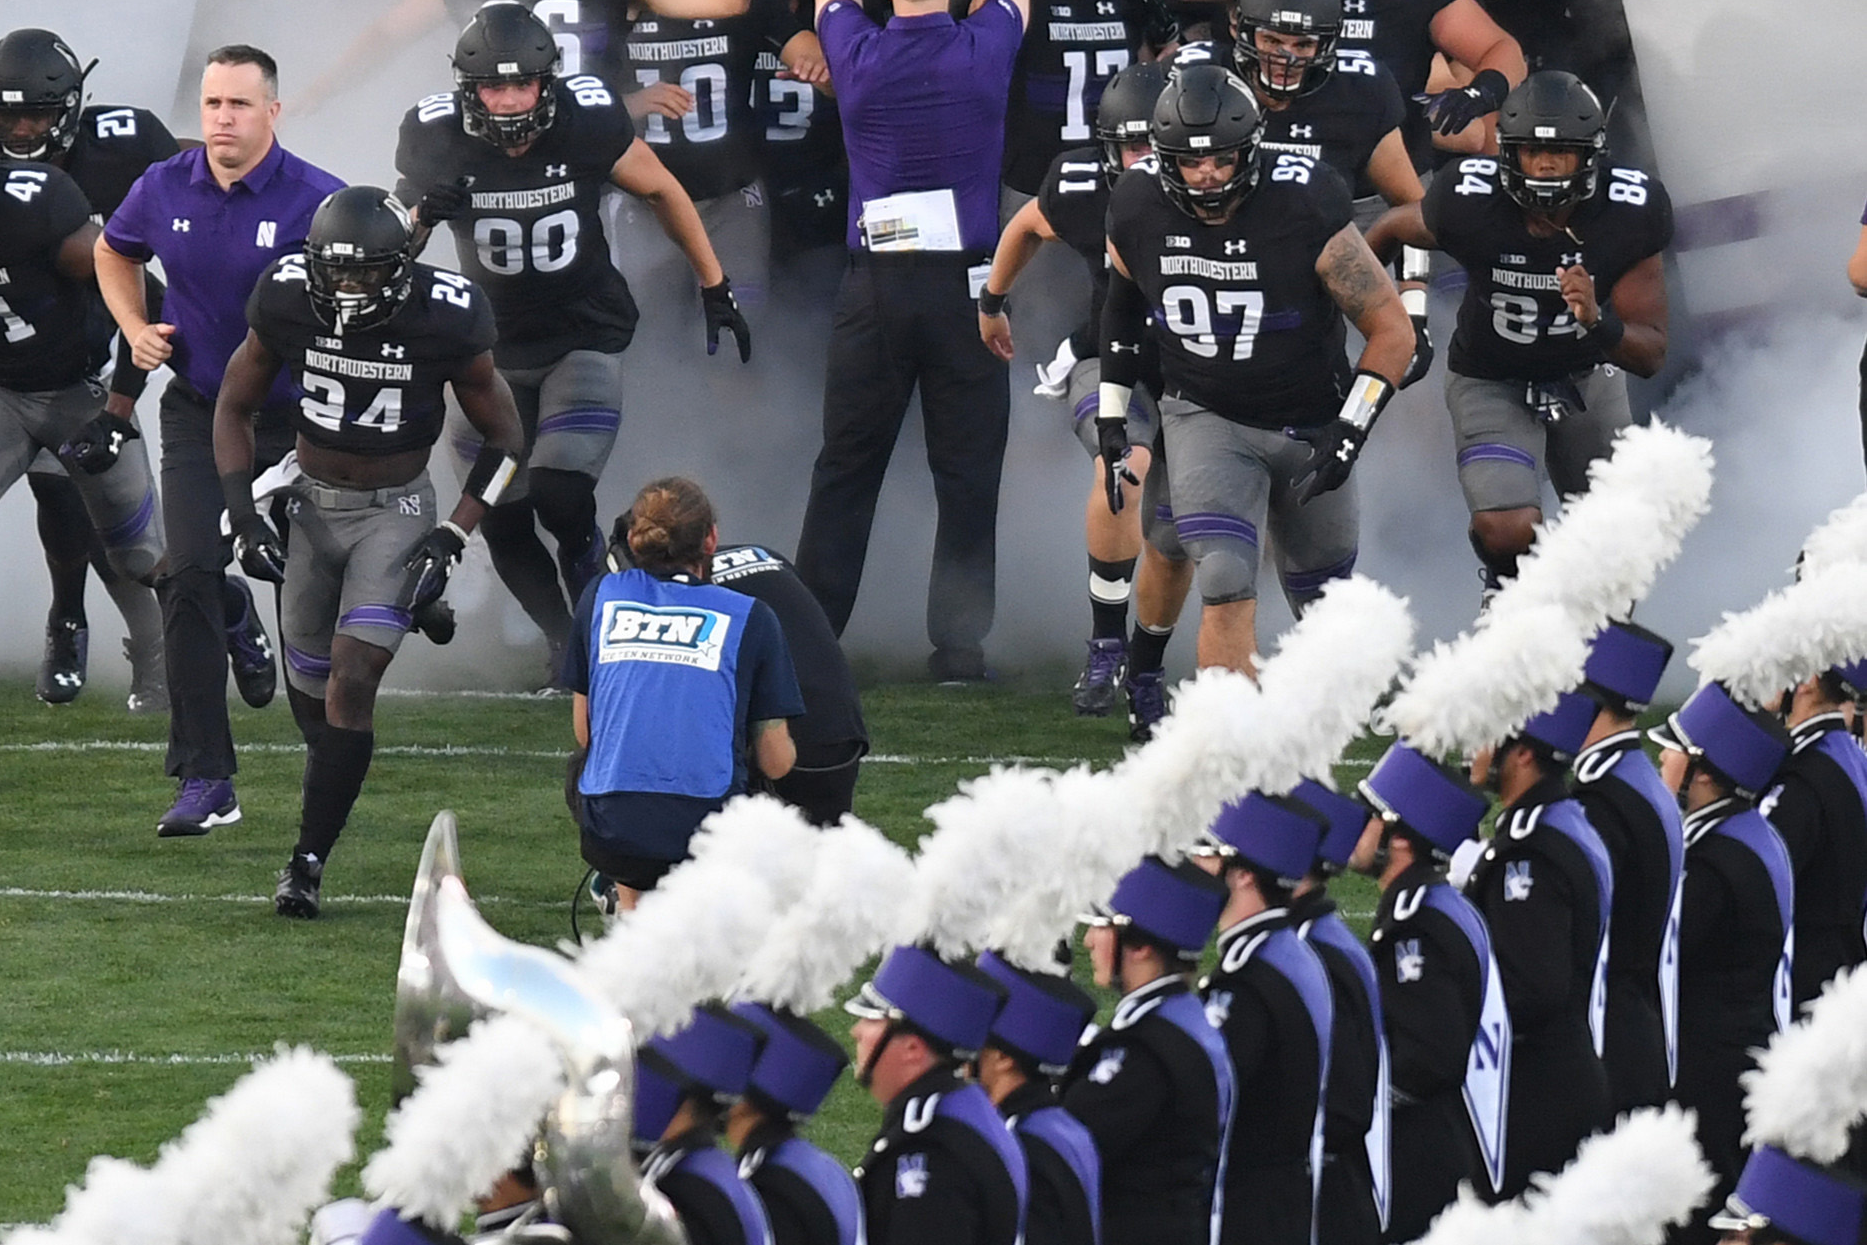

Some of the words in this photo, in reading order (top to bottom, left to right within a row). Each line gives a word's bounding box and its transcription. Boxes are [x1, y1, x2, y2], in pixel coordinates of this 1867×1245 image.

[627, 35, 729, 61] NORTHWESTERN
[417, 92, 456, 123] 80
[566, 75, 613, 108] 80
[96, 108, 136, 139] 21
[4, 169, 48, 203] 41
[1058, 161, 1099, 194] 11
[1455, 158, 1498, 196] 84
[1608, 167, 1649, 206] 84
[471, 180, 575, 210] NORTHWESTERN
[255, 221, 277, 249] N
[473, 209, 581, 275] 80
[1159, 255, 1258, 281] NORTHWESTERN
[431, 270, 473, 309] 24
[1162, 284, 1265, 361] 97
[305, 348, 413, 382] NORTHWESTERN
[299, 369, 407, 433] 24
[711, 548, 759, 573] TN
[608, 609, 705, 644] BTN
[639, 651, 700, 665] NETWORK
